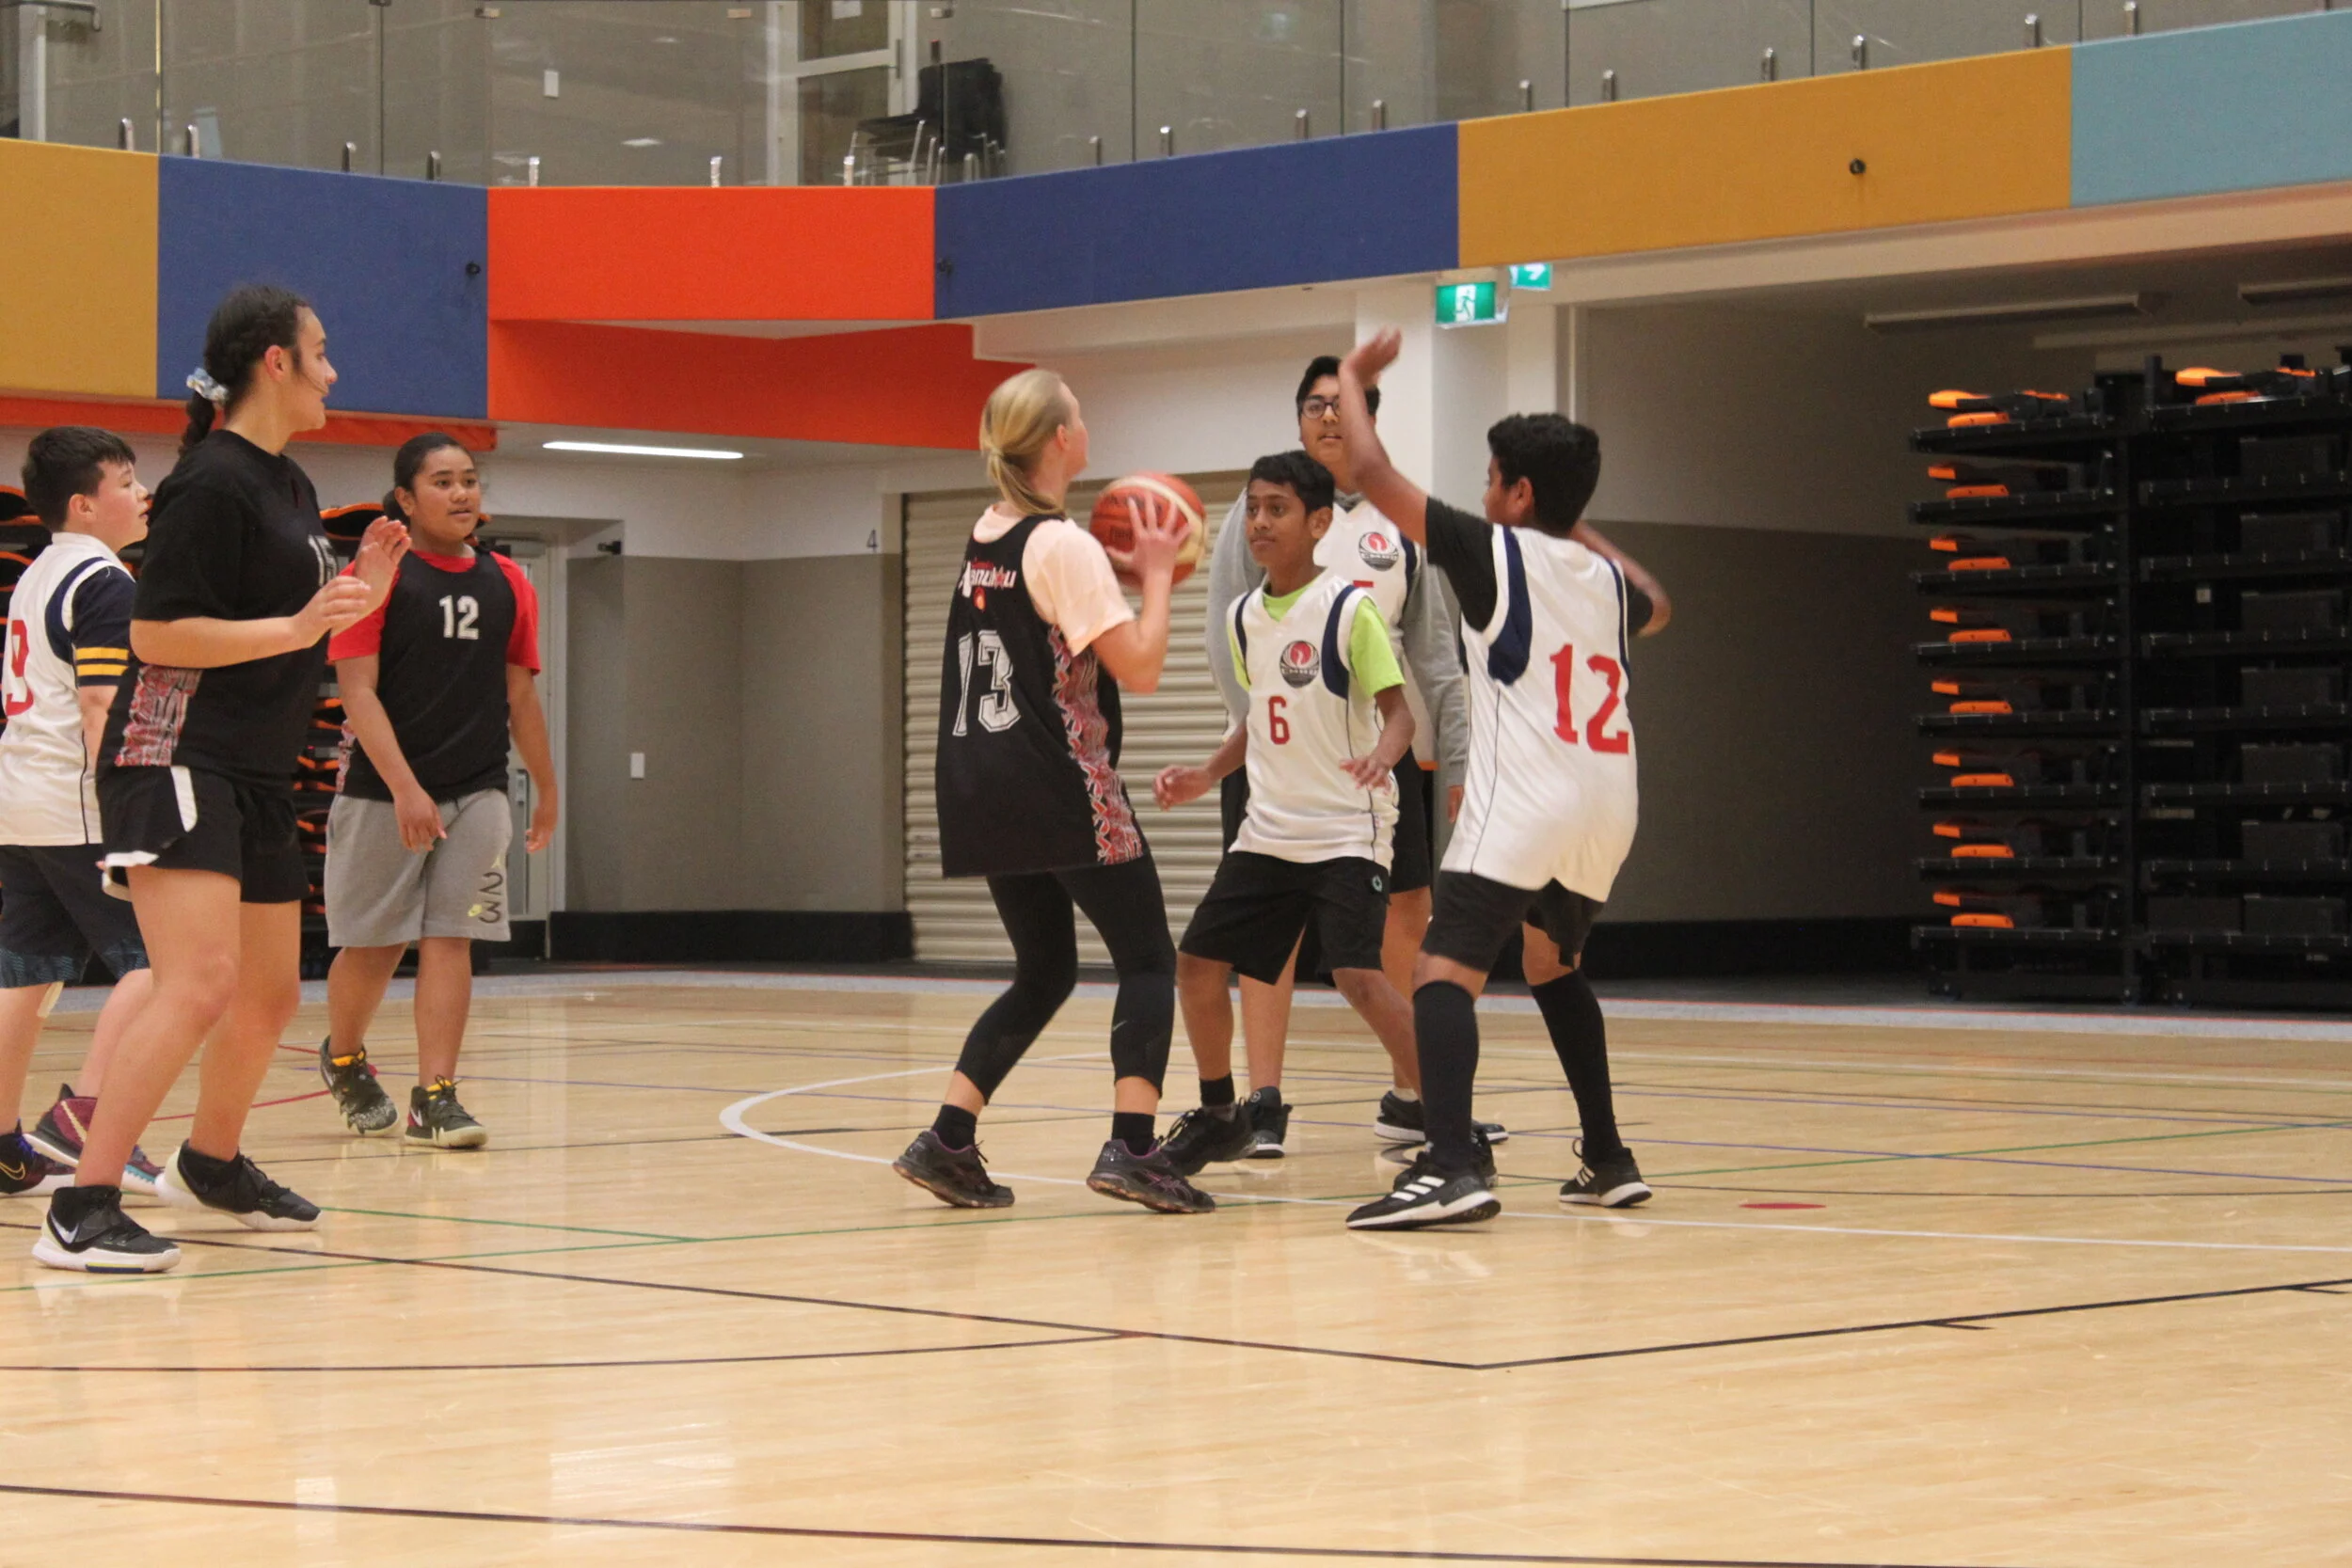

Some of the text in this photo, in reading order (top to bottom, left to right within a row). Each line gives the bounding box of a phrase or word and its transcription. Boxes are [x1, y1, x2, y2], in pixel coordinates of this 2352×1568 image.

[866, 529, 879, 552] 4
[438, 594, 479, 641] 12
[952, 629, 1021, 736] 13
[1549, 642, 1629, 754] 12
[1267, 695, 1289, 745] 6
